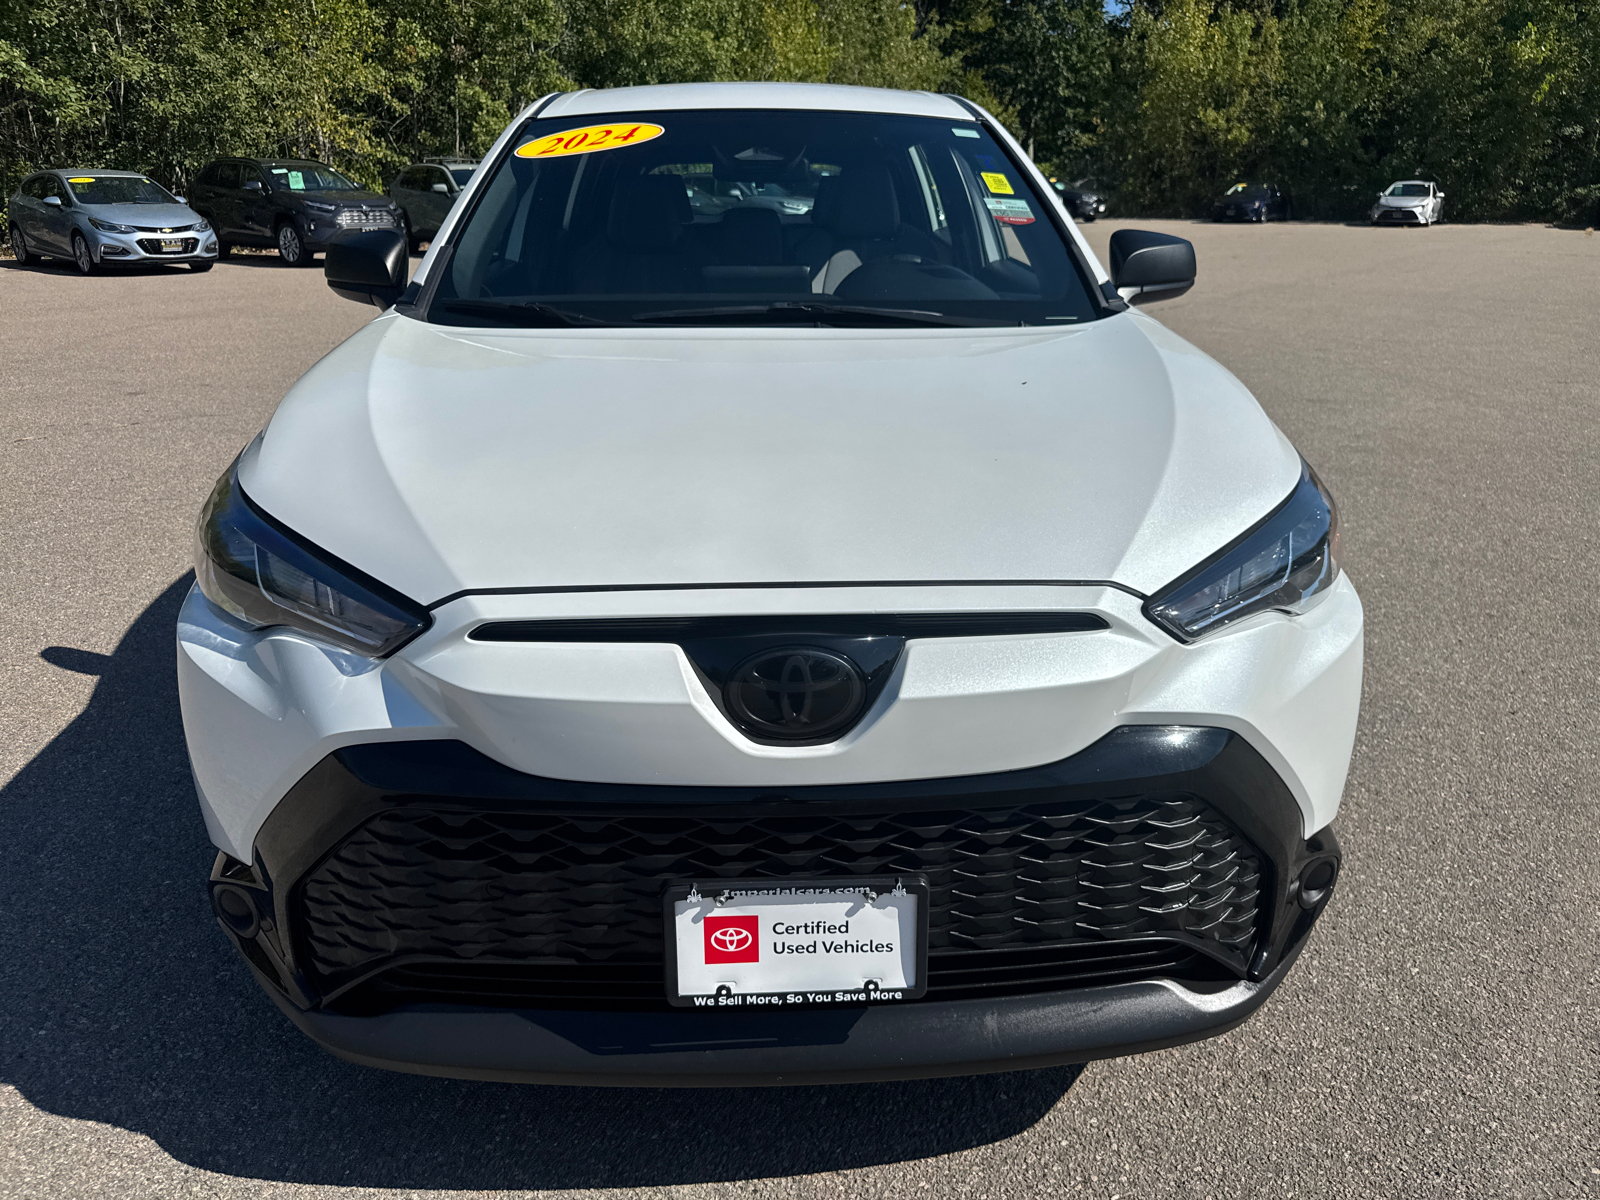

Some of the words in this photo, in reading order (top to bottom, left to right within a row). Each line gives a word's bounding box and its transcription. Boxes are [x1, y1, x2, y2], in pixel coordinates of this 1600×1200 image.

[536, 125, 642, 156] 2024
[722, 886, 871, 898] Imperialcars.com
[772, 920, 849, 935] Certified
[773, 941, 817, 955] Used
[822, 939, 894, 954] Vehicles
[693, 996, 715, 1007] We
[718, 995, 742, 1006] Sell
[746, 995, 783, 1006] More,
[786, 994, 803, 1004] So
[806, 993, 832, 1004] You
[834, 991, 866, 1002] Save
[870, 990, 903, 1001] More
